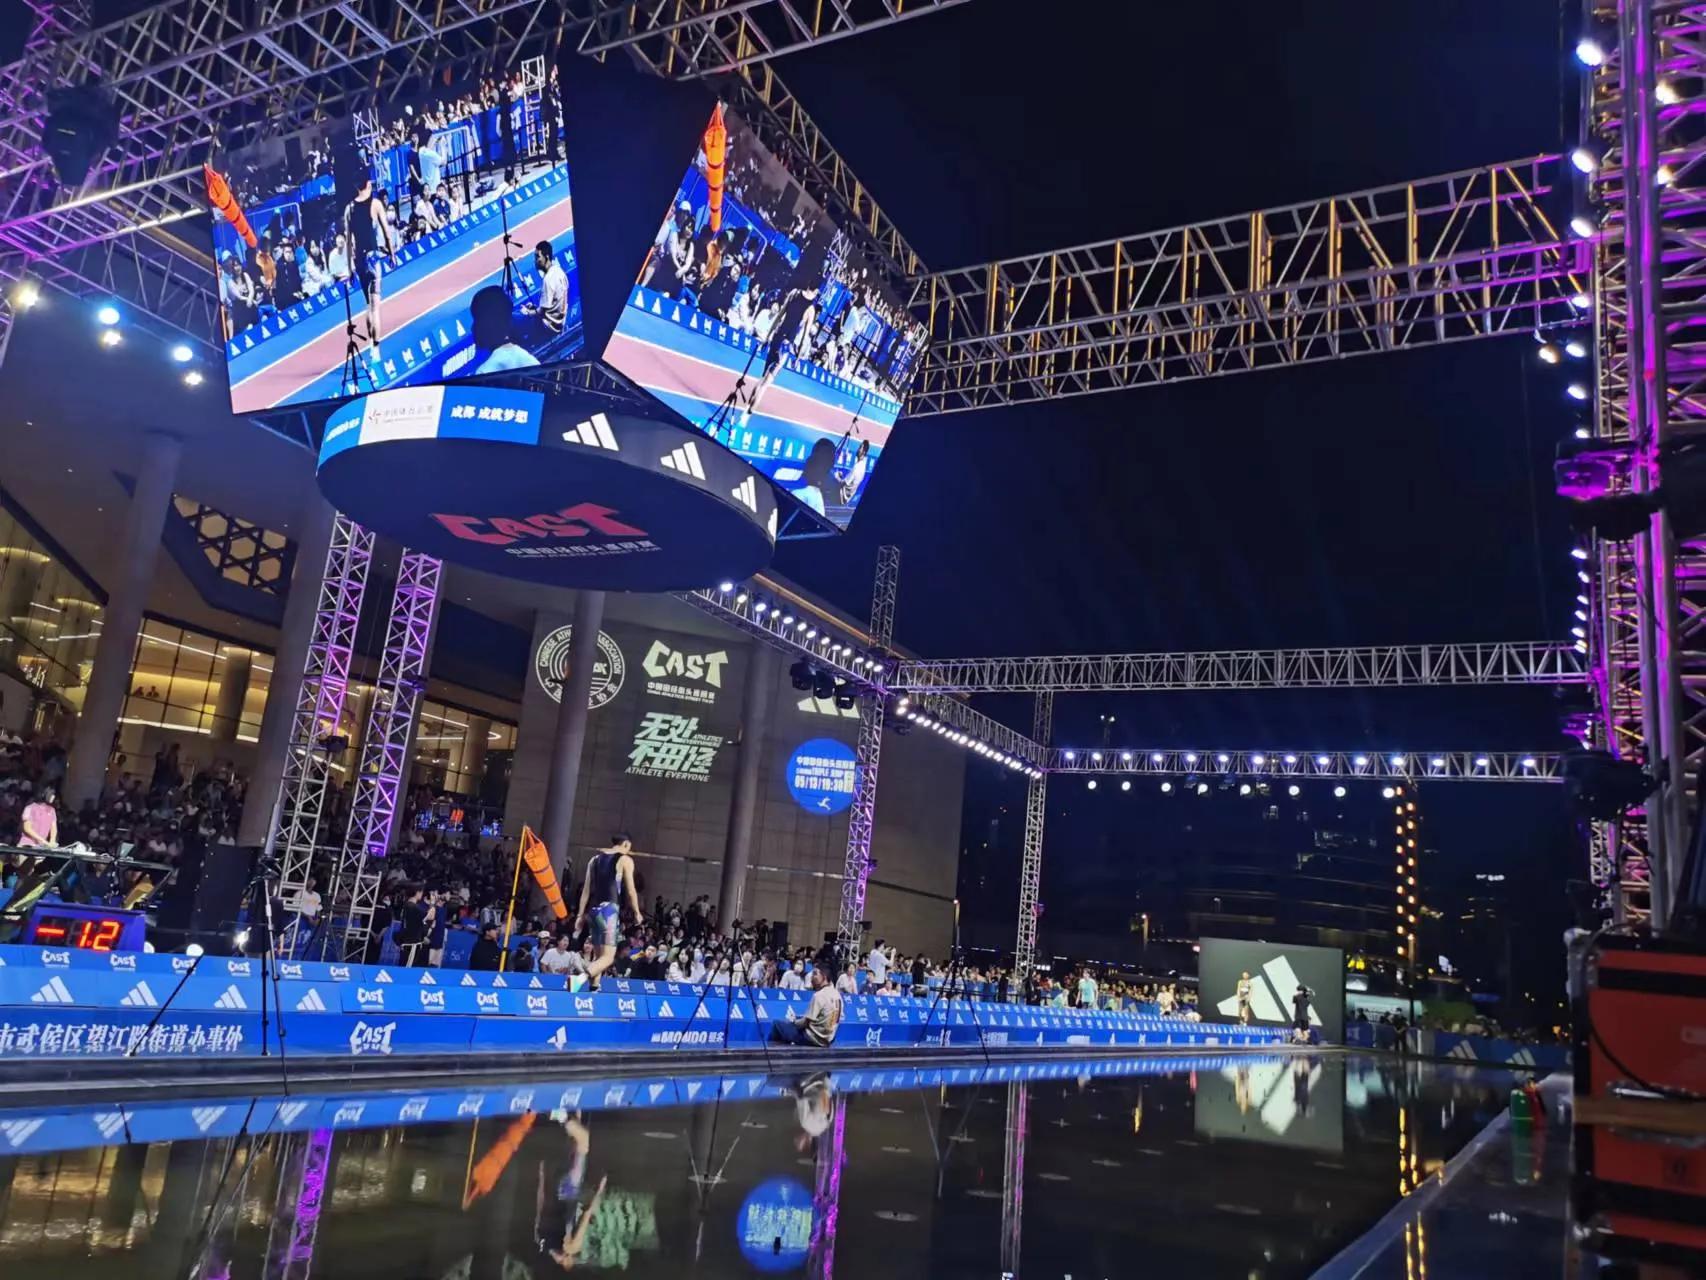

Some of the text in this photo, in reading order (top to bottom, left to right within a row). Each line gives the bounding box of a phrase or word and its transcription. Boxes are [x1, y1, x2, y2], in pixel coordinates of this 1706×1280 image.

[428, 502, 649, 545] CAST
[642, 639, 729, 689] CAST
[625, 765, 711, 783] ATHLETE EVERYONE
[41, 950, 70, 964] CAST
[110, 953, 136, 967] CAST
[228, 960, 251, 974] CAST
[281, 962, 303, 976] CAST
[330, 965, 350, 979] CAST
[357, 987, 384, 1004] CAST
[420, 989, 445, 1005] CAST
[477, 991, 500, 1006] CAST
[527, 994, 548, 1009] CAST
[350, 1021, 396, 1051] CAST
